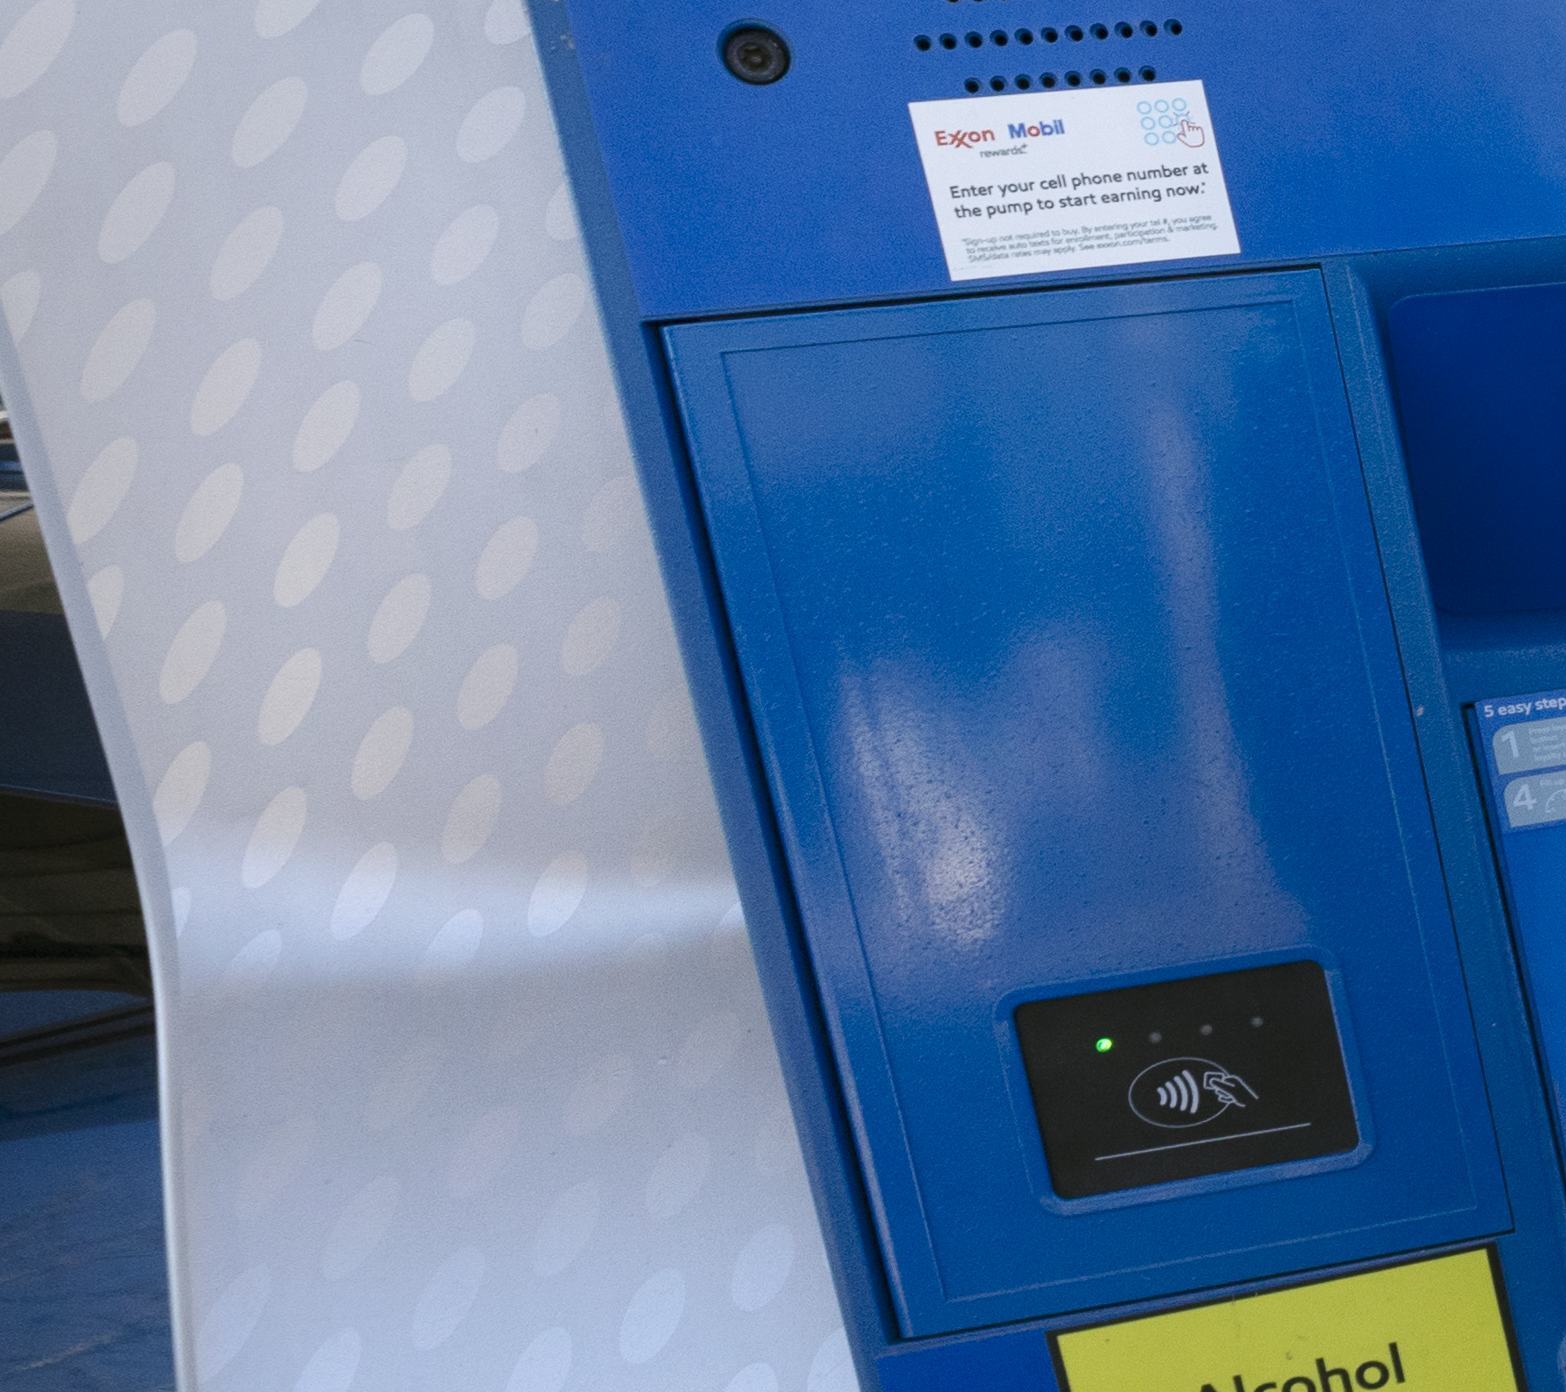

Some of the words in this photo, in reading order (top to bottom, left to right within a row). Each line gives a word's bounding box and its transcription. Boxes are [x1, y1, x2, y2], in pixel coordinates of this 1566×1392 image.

[935, 128, 995, 148] Exxon
[1007, 120, 1065, 139] Mobil
[950, 184, 994, 199] Enter
[998, 181, 1034, 197] your
[1040, 175, 1067, 190] cell
[1072, 172, 1122, 192] phone
[1127, 164, 1188, 182] number
[1193, 163, 1209, 175] at
[954, 205, 982, 219] the
[986, 201, 1033, 219] pump
[1037, 198, 1054, 210] to
[1059, 194, 1097, 209] start
[1101, 187, 1162, 205] earning
[1484, 705, 1494, 718] 5
[1498, 701, 1531, 717] easy
